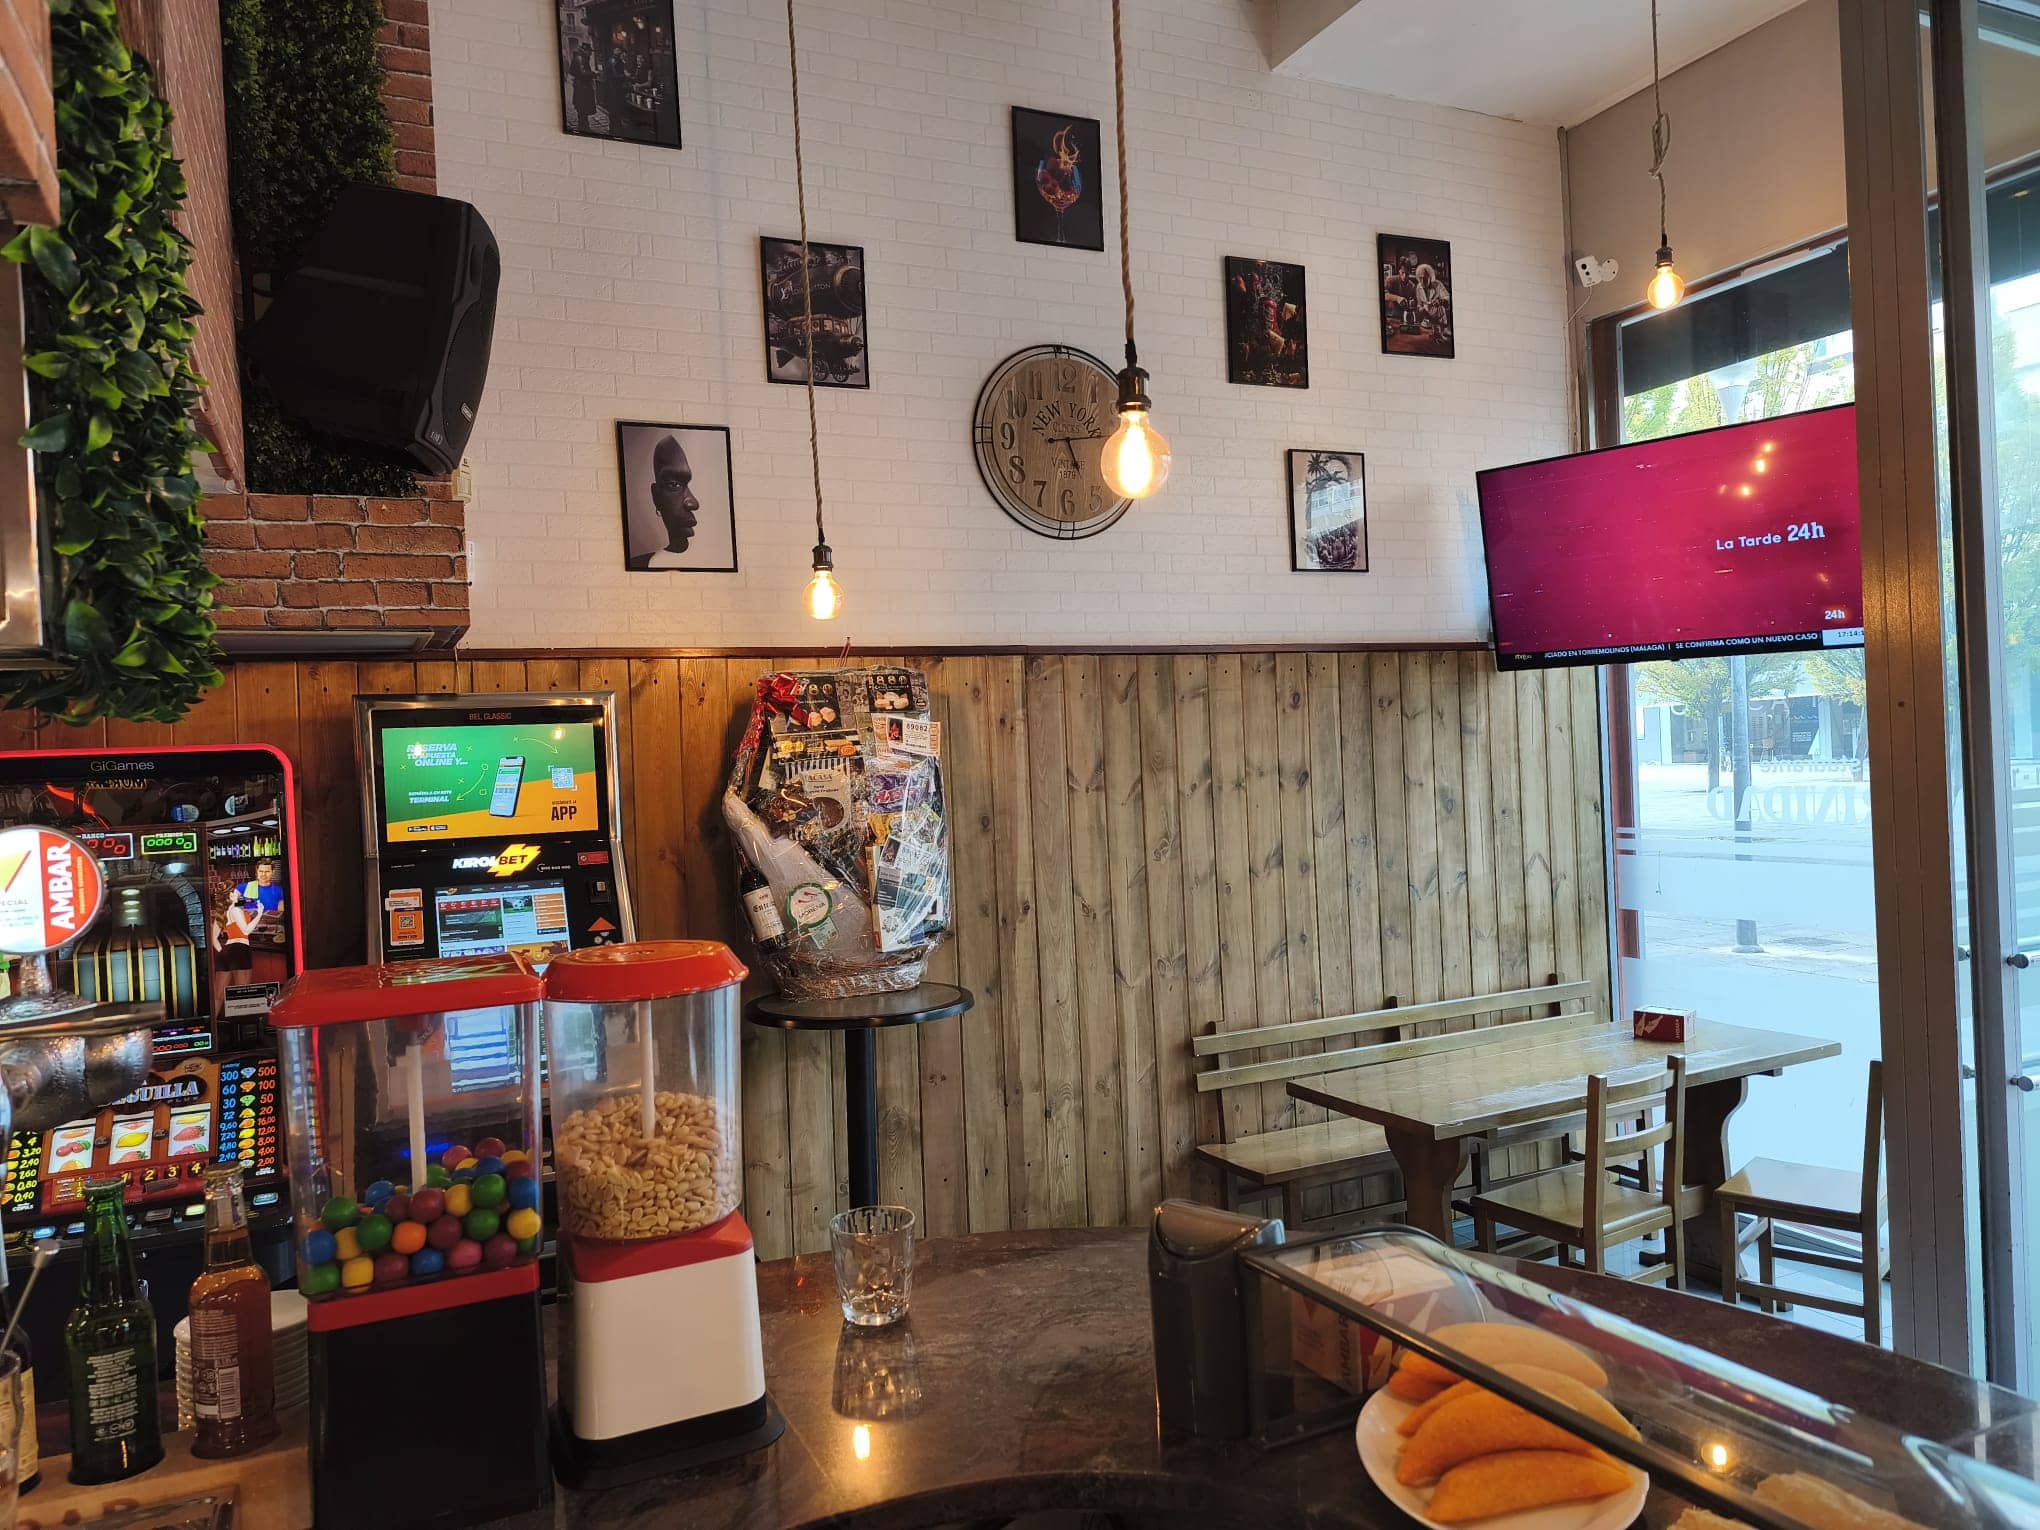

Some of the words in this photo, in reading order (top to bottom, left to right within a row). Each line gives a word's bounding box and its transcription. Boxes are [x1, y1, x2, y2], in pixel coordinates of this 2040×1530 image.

[1056, 363, 1077, 394] 12
[1007, 390, 1028, 420] 10
[1032, 400, 1061, 437] NEW
[1068, 402, 1101, 438] YORK
[1001, 422, 1015, 450] 9
[1009, 455, 1026, 484] 8
[1033, 480, 1047, 508] 7
[1089, 485, 1103, 513] 5
[1061, 489, 1075, 515] 6
[1716, 540, 1734, 551] La
[1738, 533, 1782, 547] Tarde
[1787, 521, 1825, 542] 24h
[1824, 609, 1846, 620] 24h
[1578, 646, 1630, 657] TORREMOLINOS
[1675, 641, 1685, 649] SE
[1685, 639, 1725, 649] CONFIRMA
[1725, 637, 1751, 646] COMO
[1752, 636, 1764, 644] UN
[1765, 634, 1794, 643] NUEVO
[1794, 632, 1818, 641] CASO
[468, 713, 483, 721] BEL
[483, 712, 512, 721] CLASSIC
[407, 743, 457, 753] RSERVA
[90, 760, 155, 772] GiGames
[415, 759, 453, 767] ONLINE
[551, 804, 577, 822] APP
[46, 841, 76, 930] AMBAR
[221, 1070, 239, 1082] 300
[258, 1065, 277, 1077] 500
[222, 1084, 237, 1095] 60
[258, 1079, 276, 1091] 100
[222, 1097, 236, 1109] 30
[260, 1093, 274, 1104] 50
[259, 1106, 274, 1115] 20
[168, 1165, 177, 1178] 3
[191, 1161, 201, 1174] 4
[121, 1172, 129, 1184] 1
[144, 1169, 155, 1181] 2
